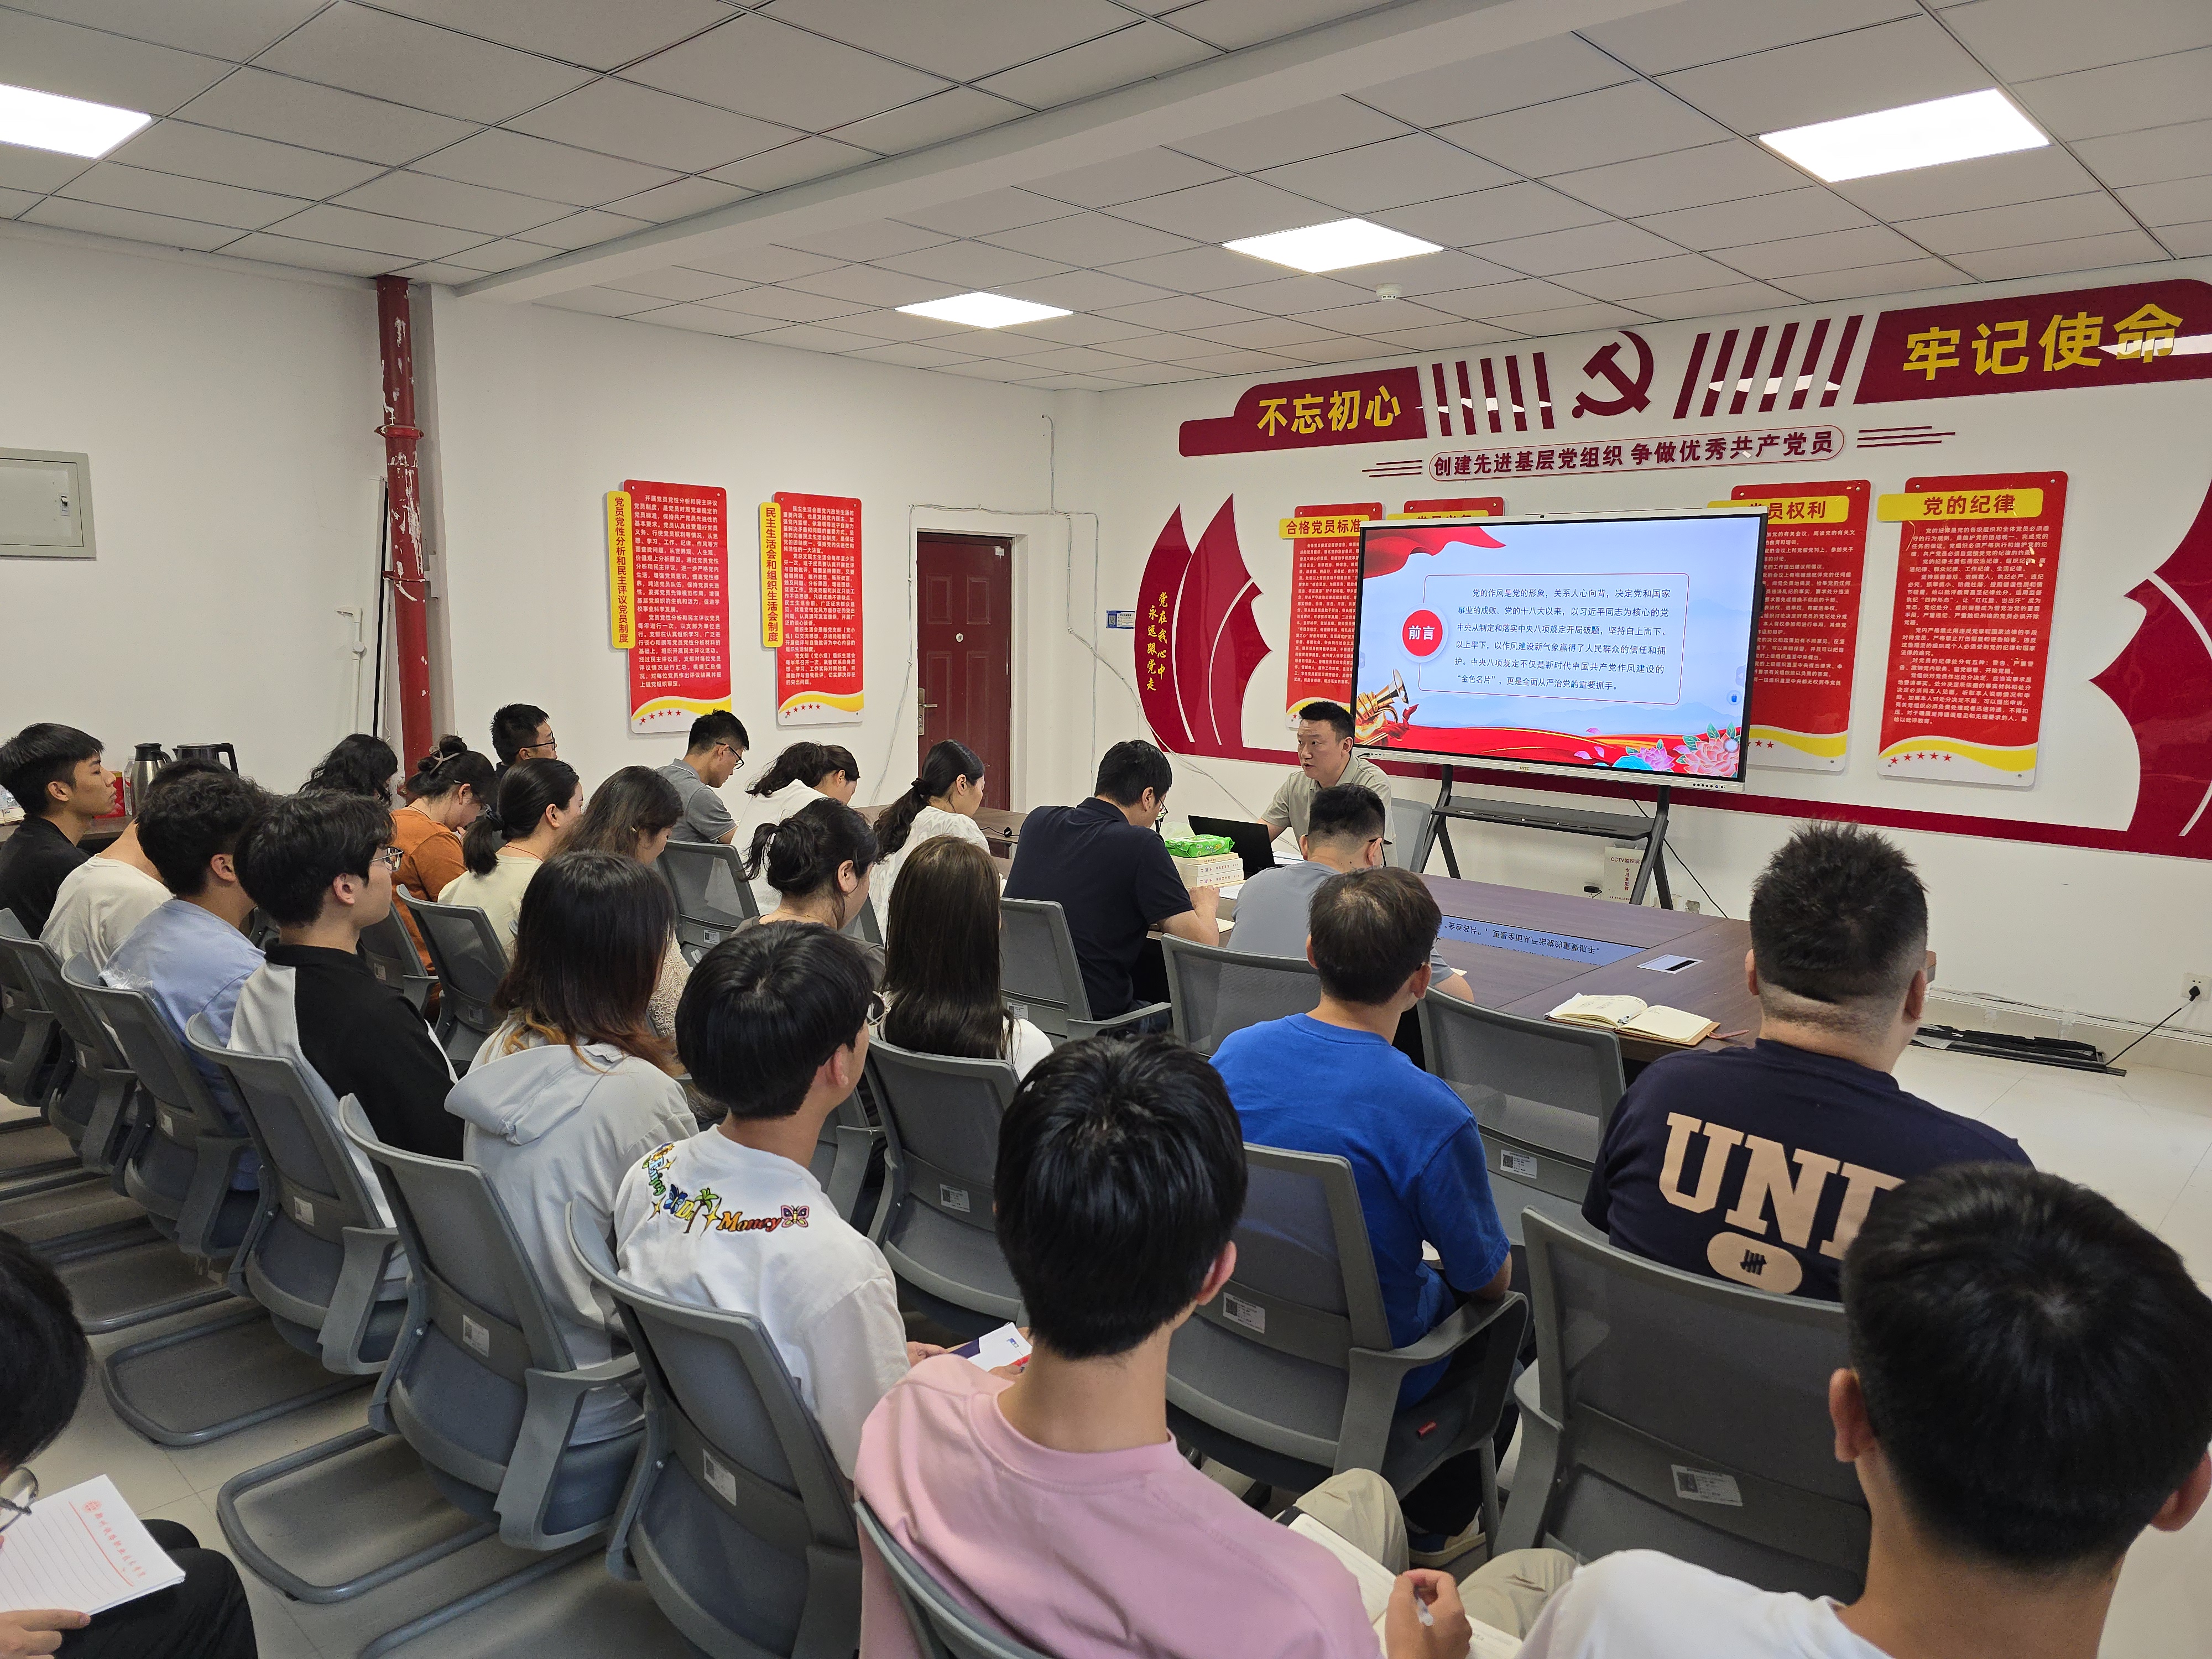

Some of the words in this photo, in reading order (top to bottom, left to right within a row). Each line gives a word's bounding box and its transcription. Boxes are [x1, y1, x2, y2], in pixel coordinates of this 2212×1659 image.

[1903, 304, 2183, 380] 牢记使命
[1258, 385, 1401, 436] 不忘初心
[1434, 445, 1624, 476] 创建先进基层党组织
[1630, 431, 1834, 465] 争做优秀共产党员
[1286, 519, 1361, 534] 合格党员标准
[1750, 500, 1826, 520] 员权利
[1923, 494, 2016, 516] 党的纪律
[615, 497, 628, 643] 党员党性分析和民主评议党员制度
[766, 508, 778, 641] 民主生活会和组织生活会制度
[1146, 605, 1159, 691] 永远跟党走
[1157, 592, 1168, 680] 党在我心中
[1408, 625, 1435, 640] 前言
